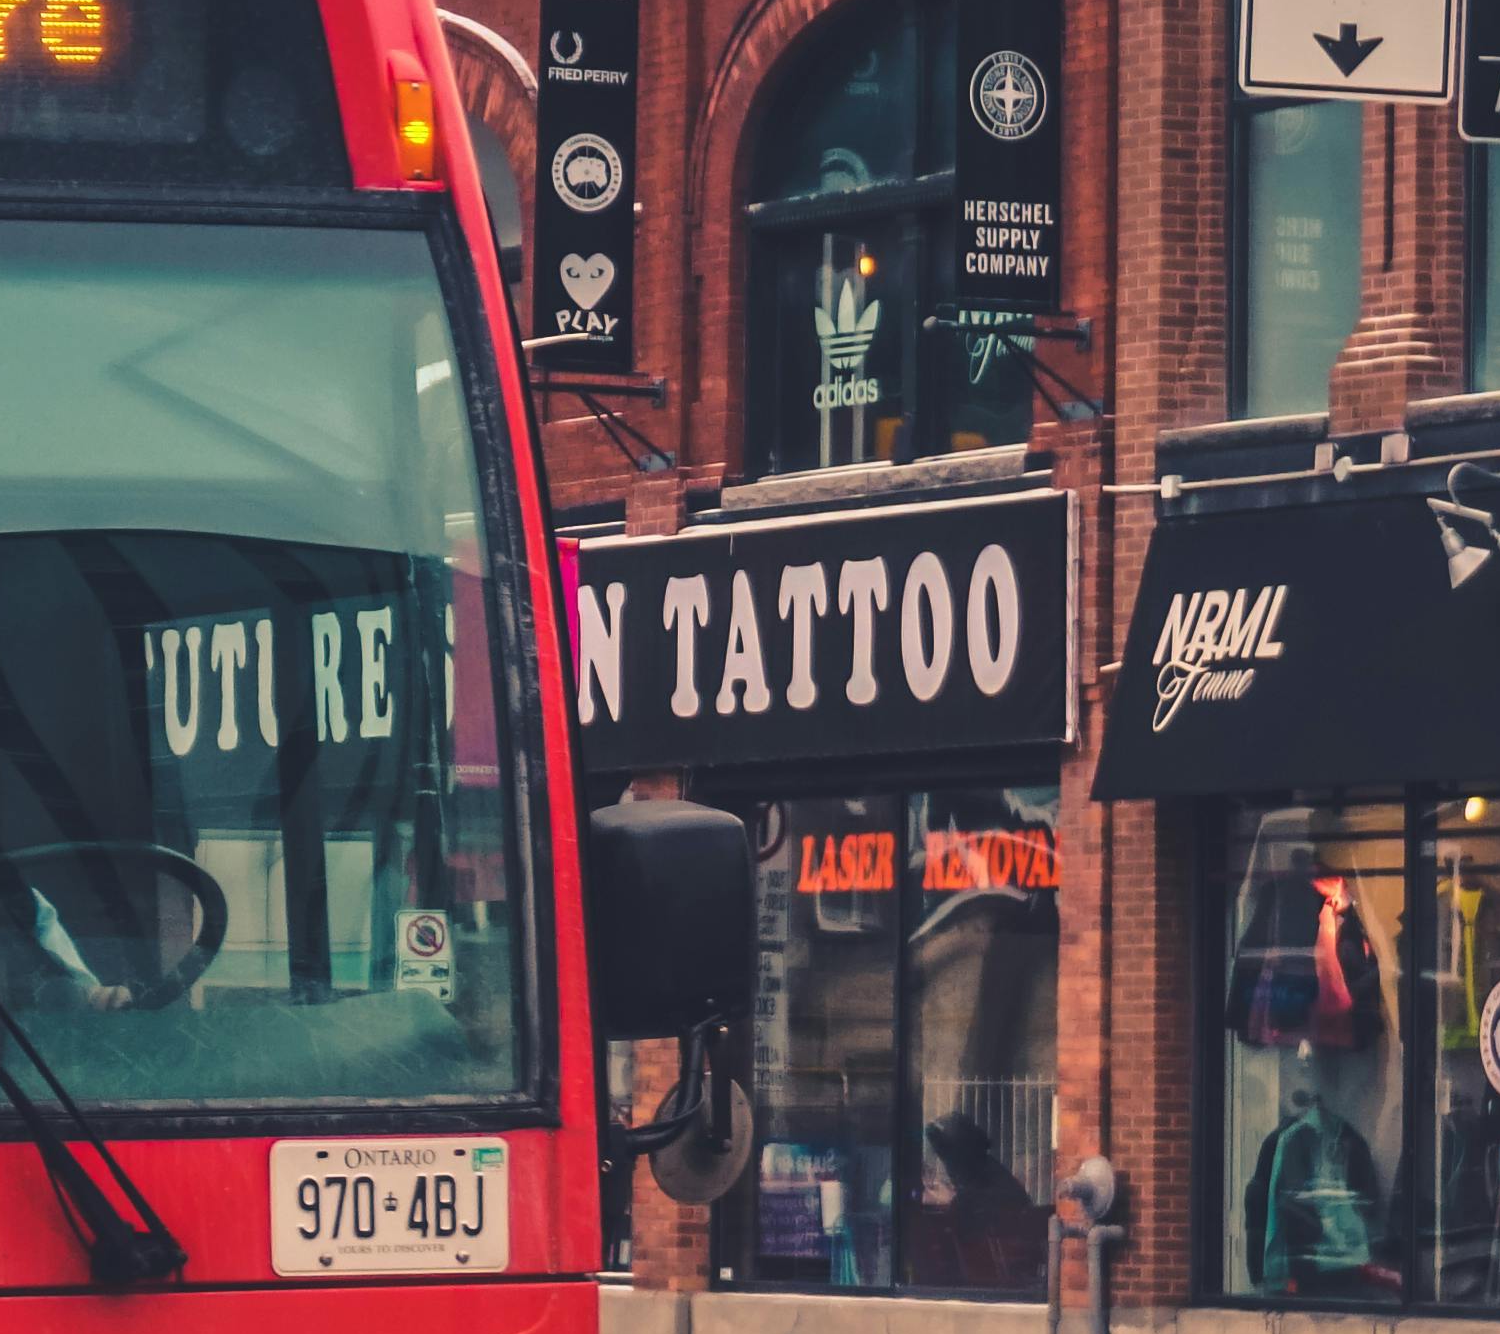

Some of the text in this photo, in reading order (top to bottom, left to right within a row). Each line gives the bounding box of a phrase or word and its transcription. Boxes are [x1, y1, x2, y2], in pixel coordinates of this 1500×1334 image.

[548, 66, 629, 86] FRED PERRY
[964, 199, 1054, 226] HERSCHEL
[975, 226, 1041, 252] SUPPLY
[965, 251, 1049, 278] COMPANY
[555, 308, 619, 335] PLAY
[813, 373, 879, 410] adidas
[1152, 584, 1288, 667] NRML
[144, 605, 394, 757] UTRE
[663, 543, 1020, 718] TATTOO
[797, 831, 895, 892] LASER
[344, 1147, 437, 1169] ONTARIO
